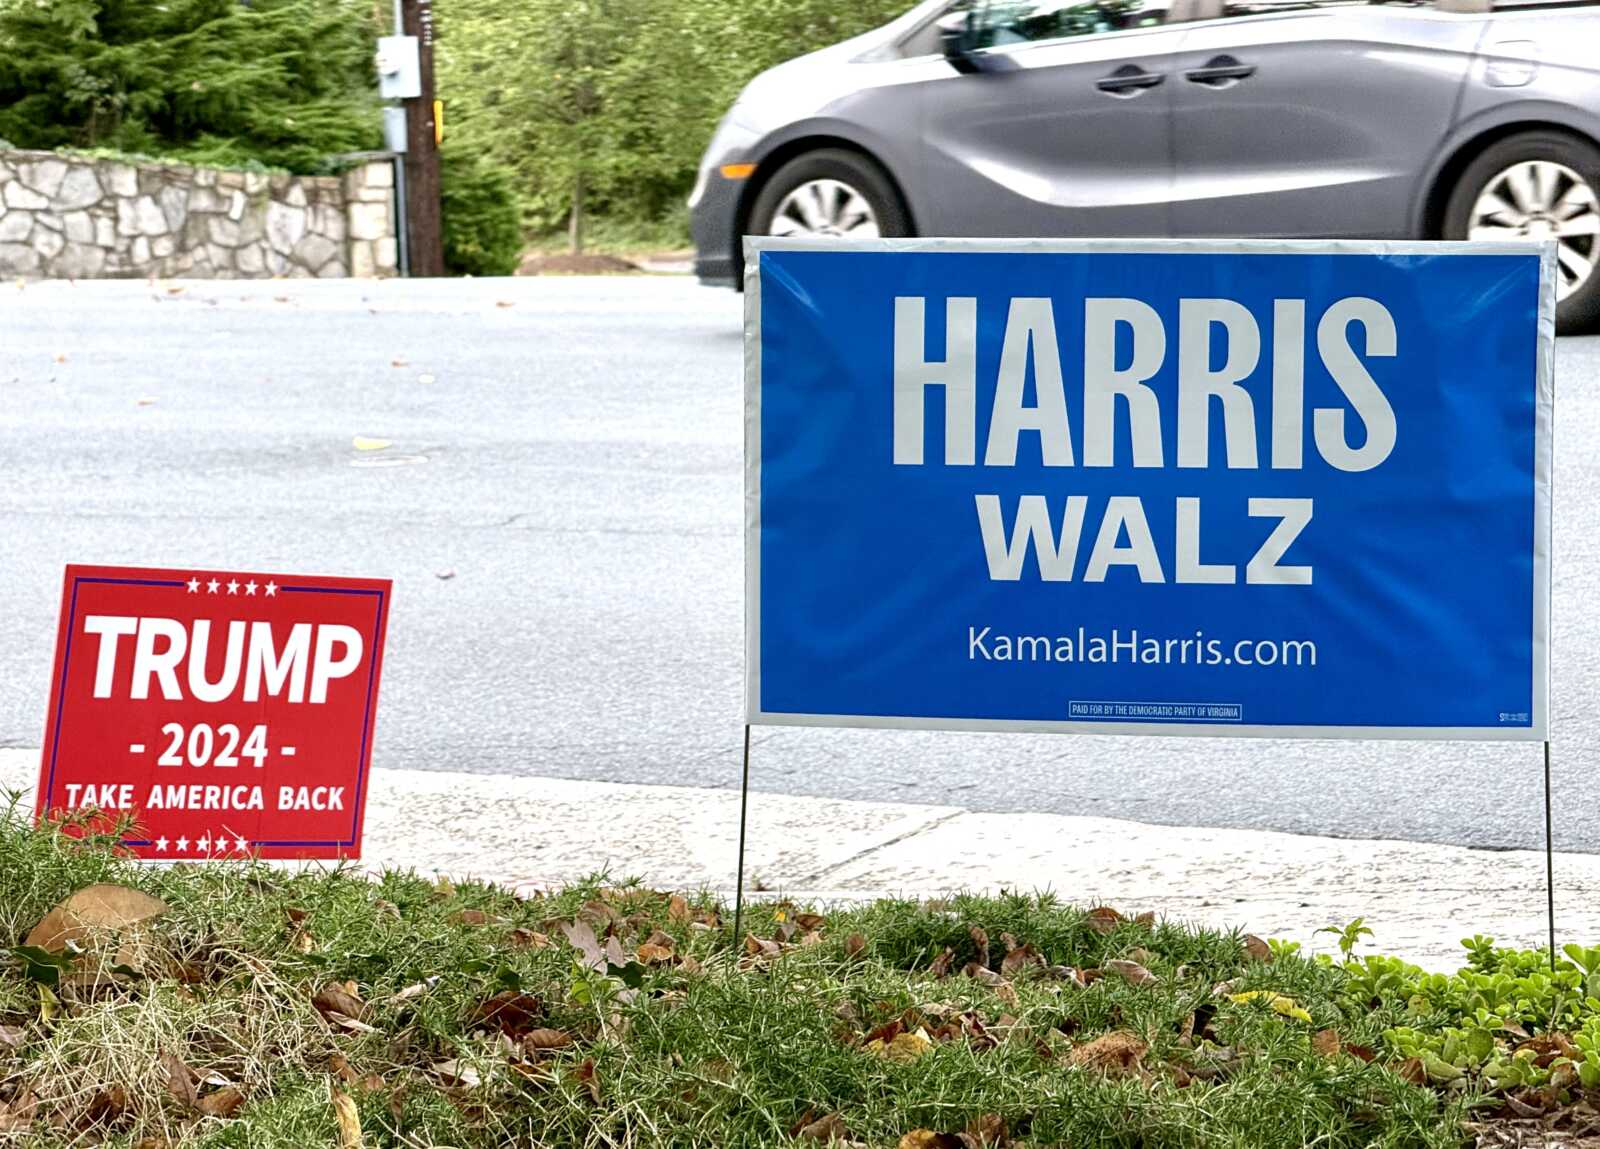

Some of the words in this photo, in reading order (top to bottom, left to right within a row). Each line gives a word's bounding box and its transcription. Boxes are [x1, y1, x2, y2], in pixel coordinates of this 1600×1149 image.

[893, 296, 1397, 472] HARRIS
[975, 494, 1314, 585] WALZ
[83, 615, 364, 704] TRUMP
[968, 625, 1317, 666] KamalaHarris.com
[1072, 704, 1088, 714] PAID
[1089, 705, 1103, 715] FOR
[1104, 705, 1113, 715] BY
[1115, 705, 1127, 715] THE
[1128, 706, 1172, 716] DEMOCRATIC
[1174, 706, 1196, 716] PARTY
[1198, 707, 1205, 717] OF
[1207, 707, 1238, 717] VIRGINIA
[157, 722, 268, 767] 2024
[65, 783, 134, 809] TAKE
[146, 784, 264, 810] AMERICA
[278, 786, 345, 811] BACK
